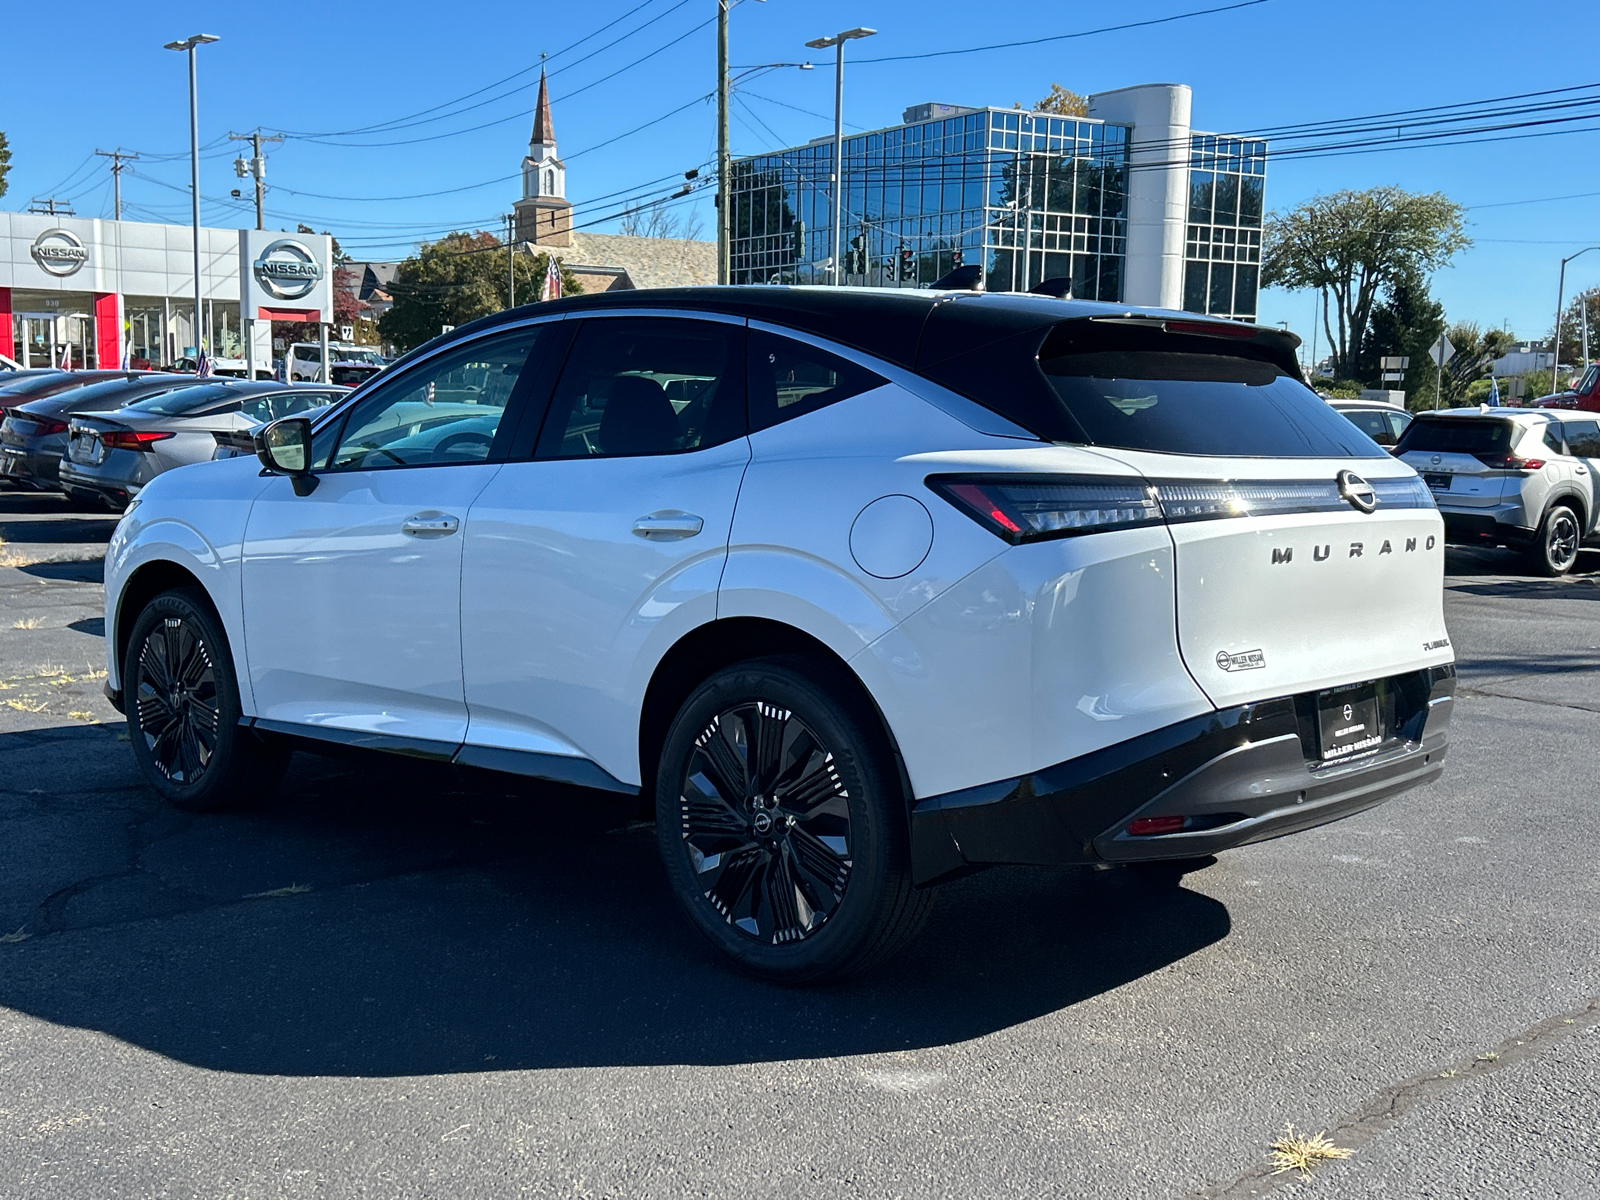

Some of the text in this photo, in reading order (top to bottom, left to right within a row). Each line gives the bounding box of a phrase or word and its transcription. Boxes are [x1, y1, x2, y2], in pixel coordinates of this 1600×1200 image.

[37, 248, 84, 257] NISSAN
[262, 263, 318, 275] NISSAN
[1271, 534, 1436, 565] MURANO
[1324, 735, 1381, 759] MILLER NISSAN
